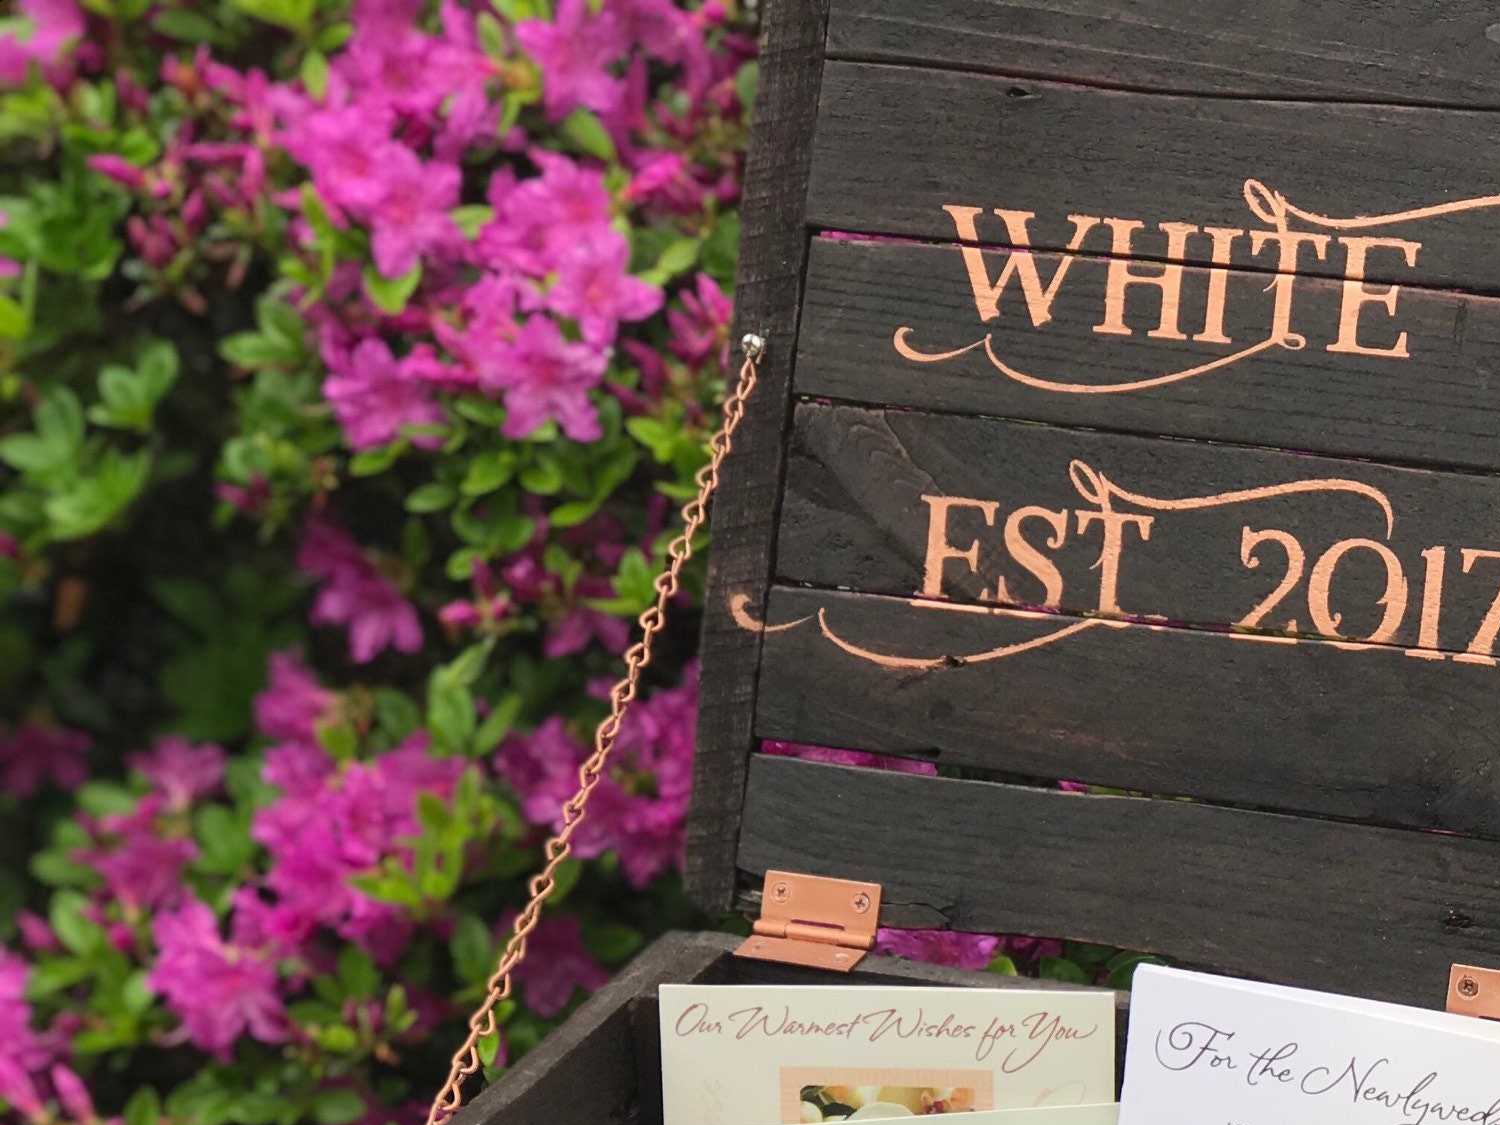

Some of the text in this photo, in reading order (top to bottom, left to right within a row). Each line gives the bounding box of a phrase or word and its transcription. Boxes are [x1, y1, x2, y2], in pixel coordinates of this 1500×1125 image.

[942, 178, 1421, 358] WHITE
[675, 1002, 1098, 1074] Our Warmest Wishes for You
[1154, 1021, 1237, 1071] For
[1245, 1042, 1299, 1086] the
